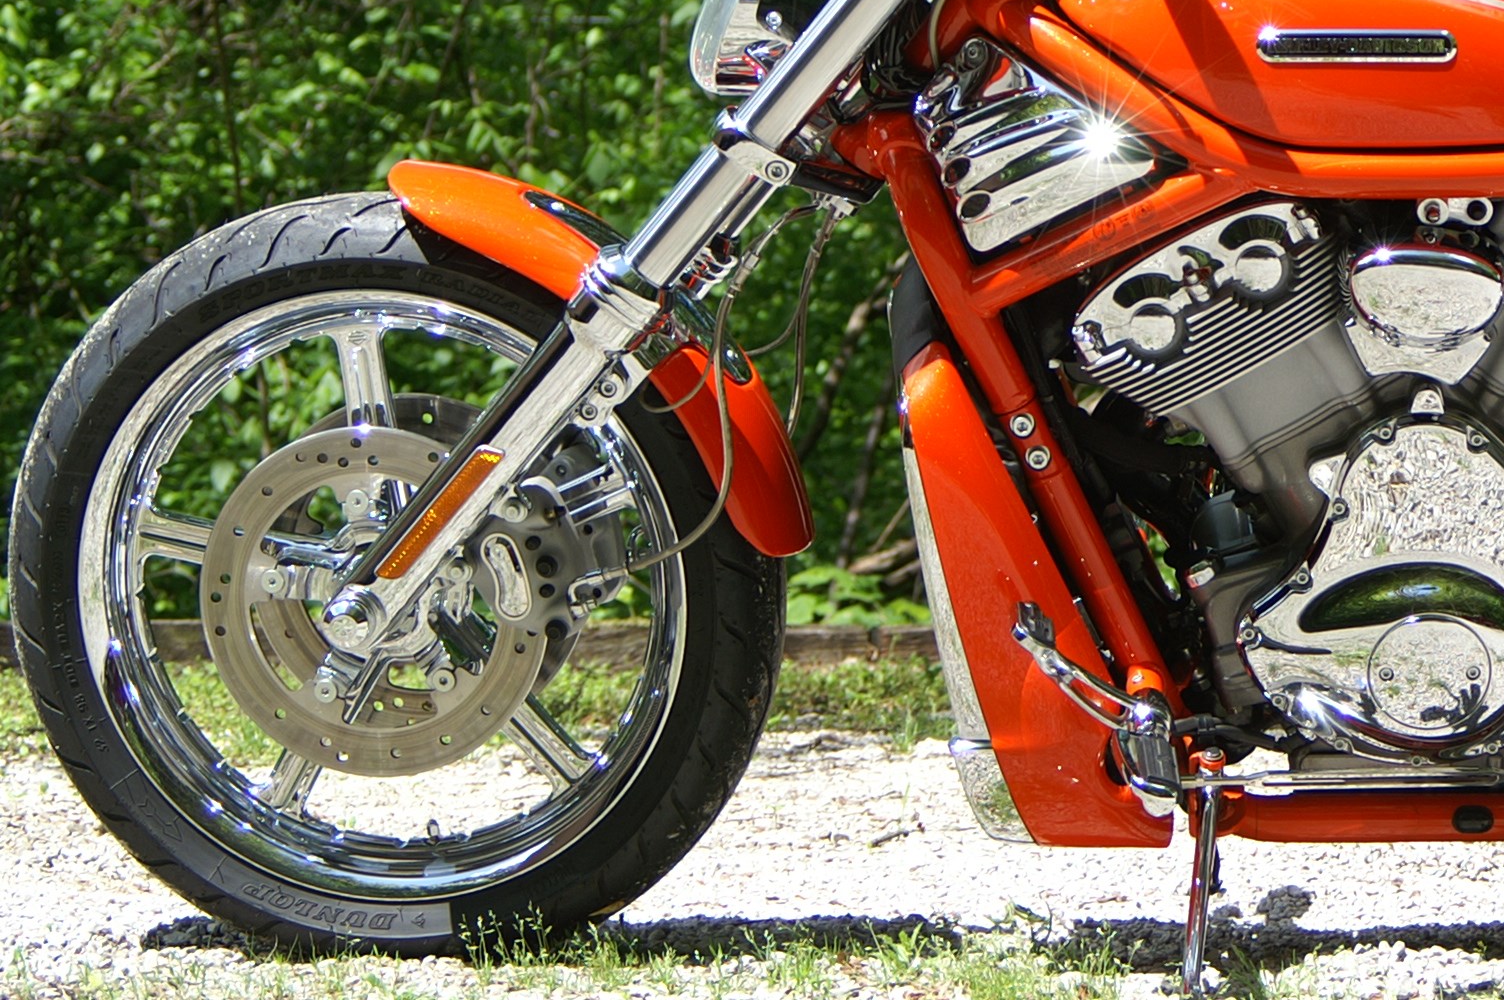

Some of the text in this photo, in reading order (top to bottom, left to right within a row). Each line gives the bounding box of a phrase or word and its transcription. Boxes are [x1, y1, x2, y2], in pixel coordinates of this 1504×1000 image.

[199, 261, 547, 325] SPORTMAX RADIAL
[241, 882, 398, 931] DUNLOP
